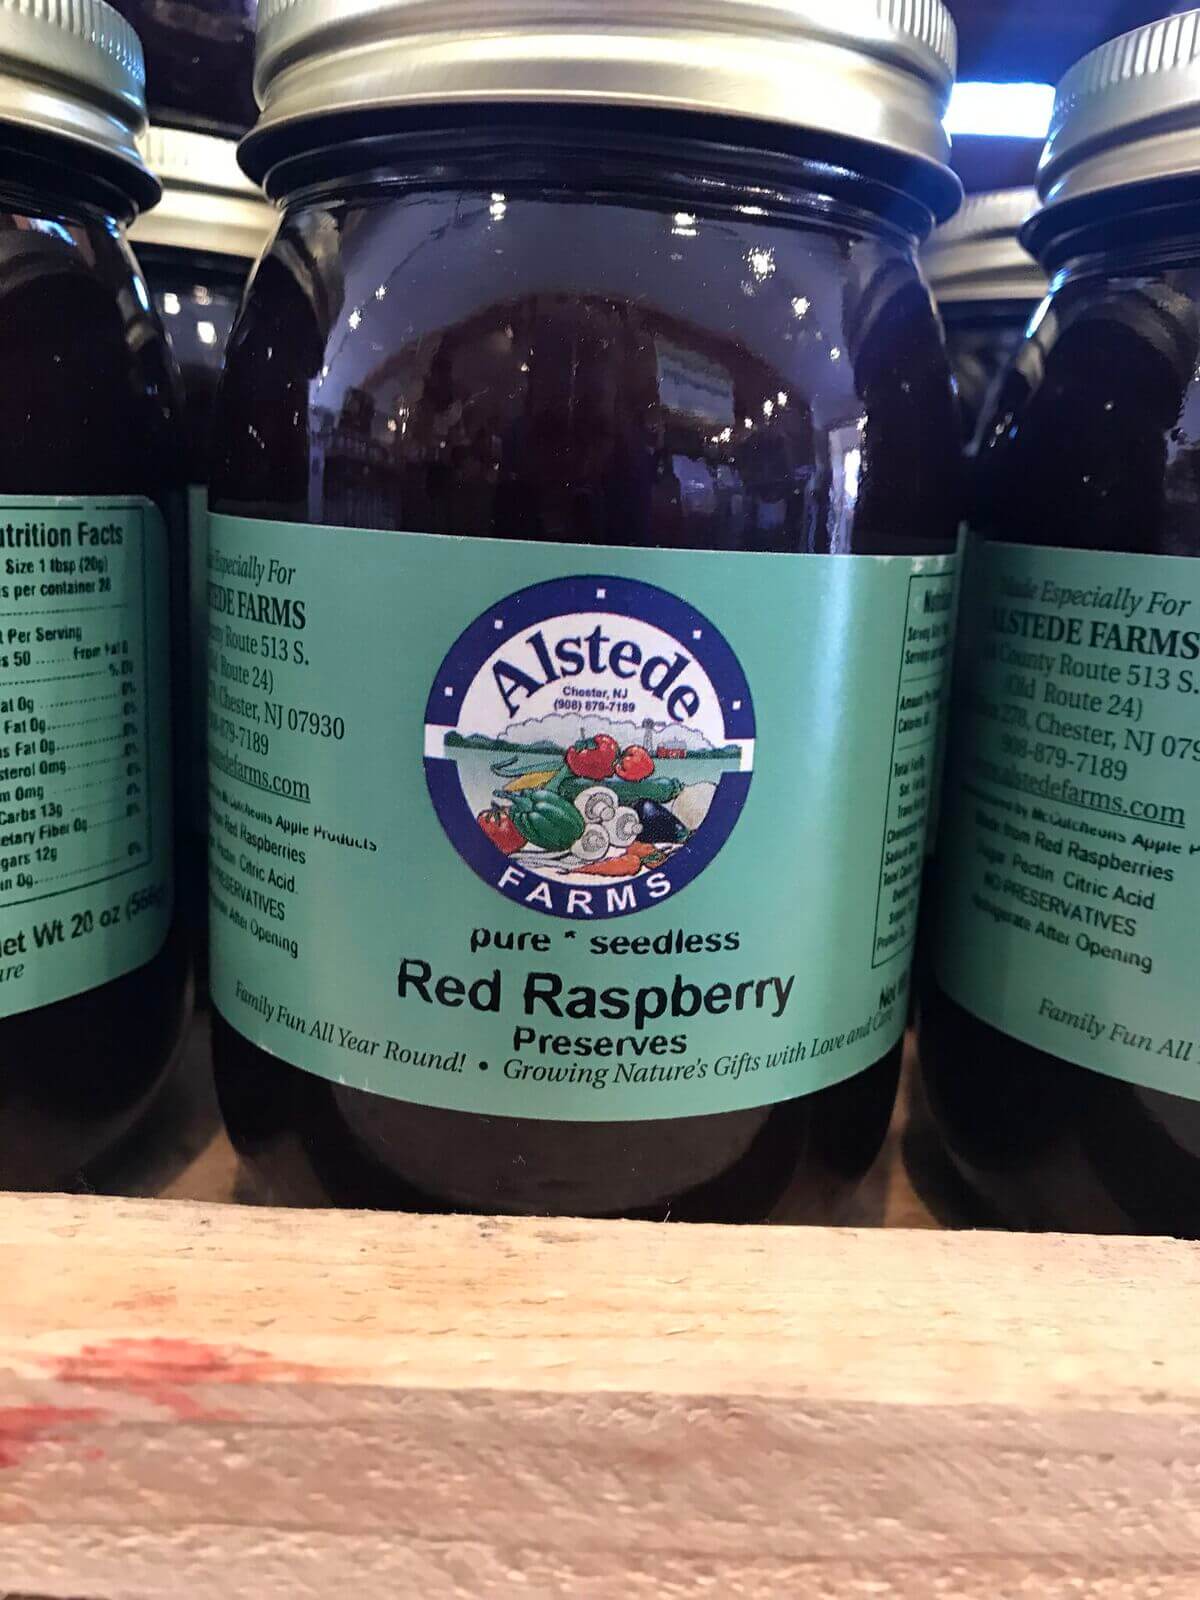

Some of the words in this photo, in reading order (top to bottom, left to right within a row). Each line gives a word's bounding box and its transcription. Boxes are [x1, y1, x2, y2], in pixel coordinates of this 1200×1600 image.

[78, 522, 123, 546] Facts
[5, 558, 34, 574] Size
[39, 558, 45, 573] 1
[268, 558, 296, 585] For
[14, 586, 35, 600] per
[40, 581, 95, 597] container
[238, 590, 306, 630] FARMS
[1042, 580, 1143, 619] Especially
[1146, 591, 1191, 617] For
[8, 628, 31, 644] Per
[36, 626, 82, 642] Serving
[226, 625, 258, 655] Route
[261, 634, 288, 661] 513
[293, 640, 309, 665] S.
[1088, 620, 1200, 660] FARMS
[14, 651, 31, 666] 50
[492, 624, 700, 722] Alstede
[1060, 653, 1121, 684] Route
[1127, 664, 1170, 690] 513
[1177, 669, 1199, 694] S.
[252, 666, 274, 695] 24)
[613, 687, 628, 698] NJ
[264, 701, 284, 730] NJ
[288, 708, 345, 740] 07930
[553, 699, 582, 712] (908)
[1044, 682, 1102, 713] Route
[1108, 693, 1143, 722] 24)
[4, 719, 27, 734] Fat
[1036, 711, 1116, 749] Chester,
[1124, 728, 1156, 756] NJ
[15, 740, 36, 756] Fat
[0, 807, 36, 825] Carbs
[1035, 831, 1063, 855] Red
[1068, 841, 1174, 882] Raspberries
[498, 866, 671, 915] FARMS
[1063, 871, 1108, 899] Citric
[33, 918, 65, 949] Wt
[71, 909, 94, 940] 20
[100, 905, 120, 928] oz
[1003, 879, 1137, 937] PRESERVATIVES
[250, 918, 298, 959] Opening
[470, 927, 551, 953] pure
[589, 928, 740, 955] seedless
[1075, 933, 1153, 974] Opening
[397, 957, 501, 1013] Red
[524, 972, 795, 1030] Raspberry
[235, 980, 275, 1022] Family
[277, 1004, 306, 1034] Fun
[309, 1020, 334, 1044] All
[338, 1027, 380, 1056] Year
[383, 1039, 467, 1073] Round!
[503, 1058, 609, 1089] Growing
[612, 1058, 708, 1084] Nature's
[714, 1052, 761, 1080] Gifts
[766, 1041, 806, 1068] with
[810, 1033, 845, 1058] Love
[846, 1016, 872, 1046] and
[513, 1025, 688, 1057] Preserves
[1038, 998, 1106, 1040] Family
[1109, 1022, 1152, 1051] Fun
[1157, 1039, 1193, 1061] All
